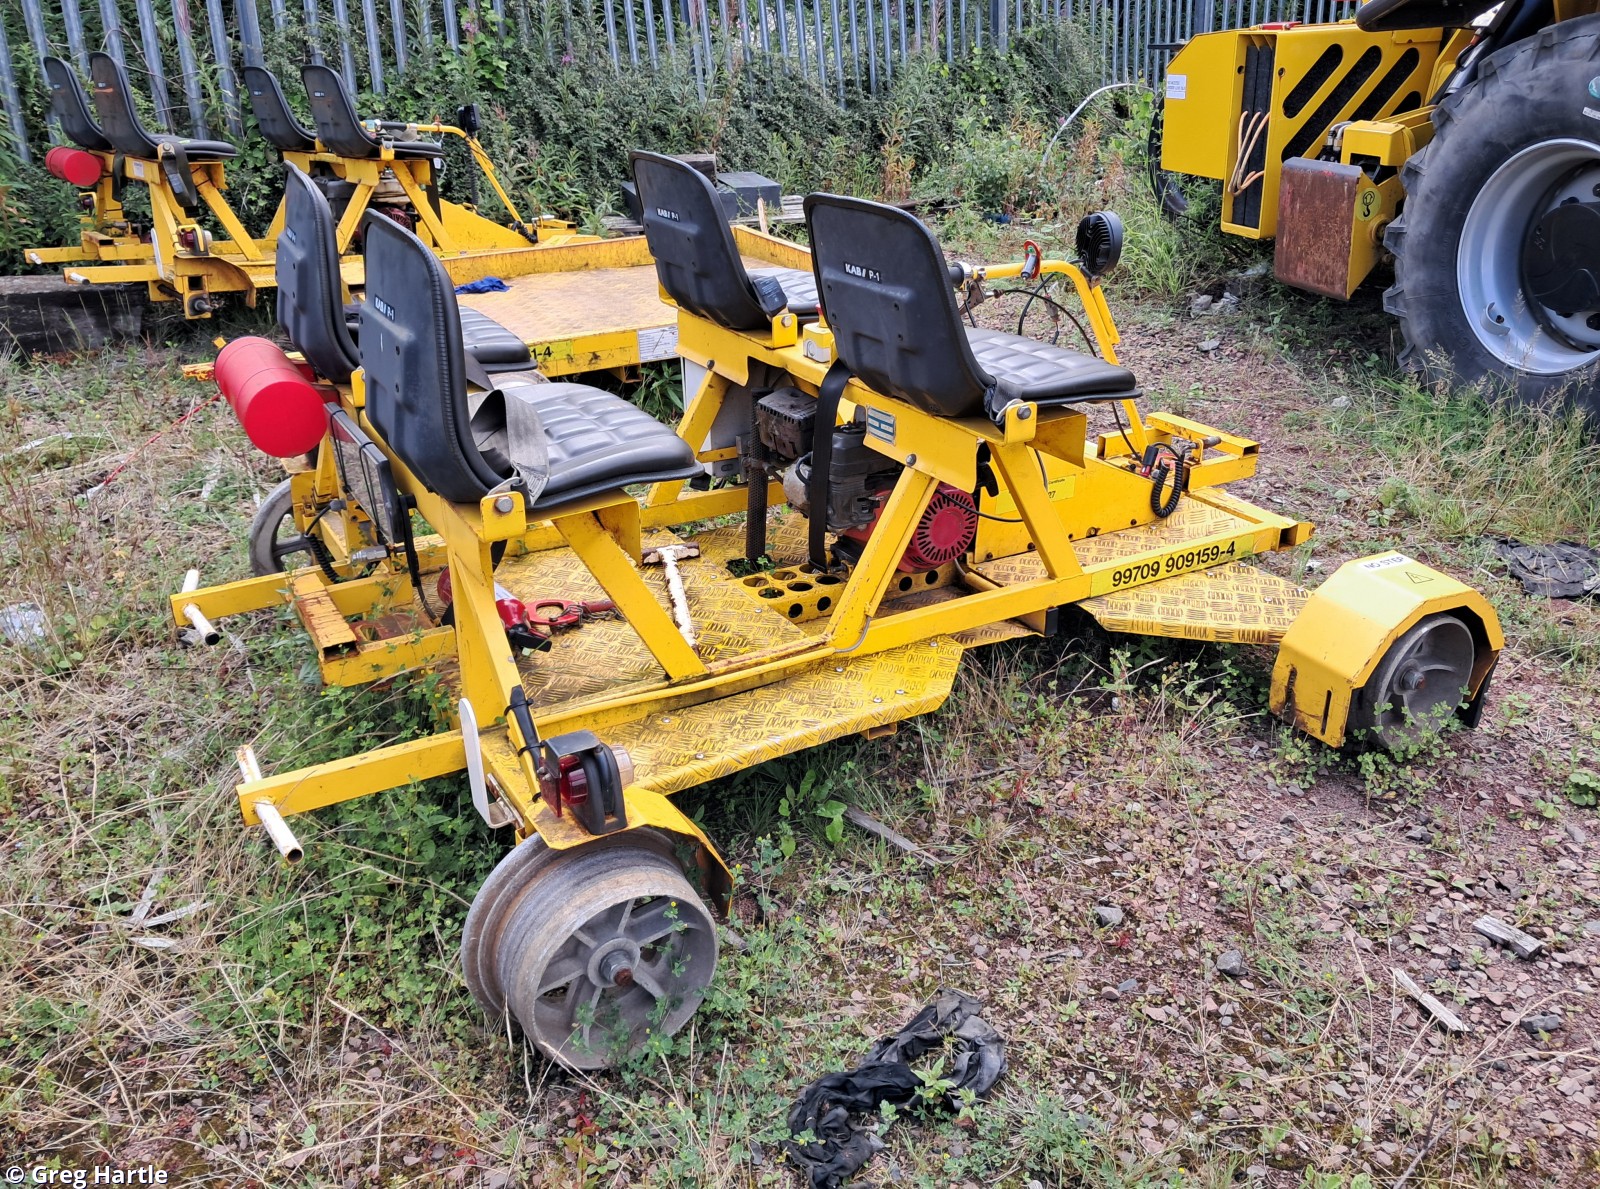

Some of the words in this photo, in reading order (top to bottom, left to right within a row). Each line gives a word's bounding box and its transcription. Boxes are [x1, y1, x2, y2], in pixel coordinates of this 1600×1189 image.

[868, 269, 880, 281] P-1
[1112, 560, 1160, 587] 99709
[1165, 540, 1235, 573] 909159-4
